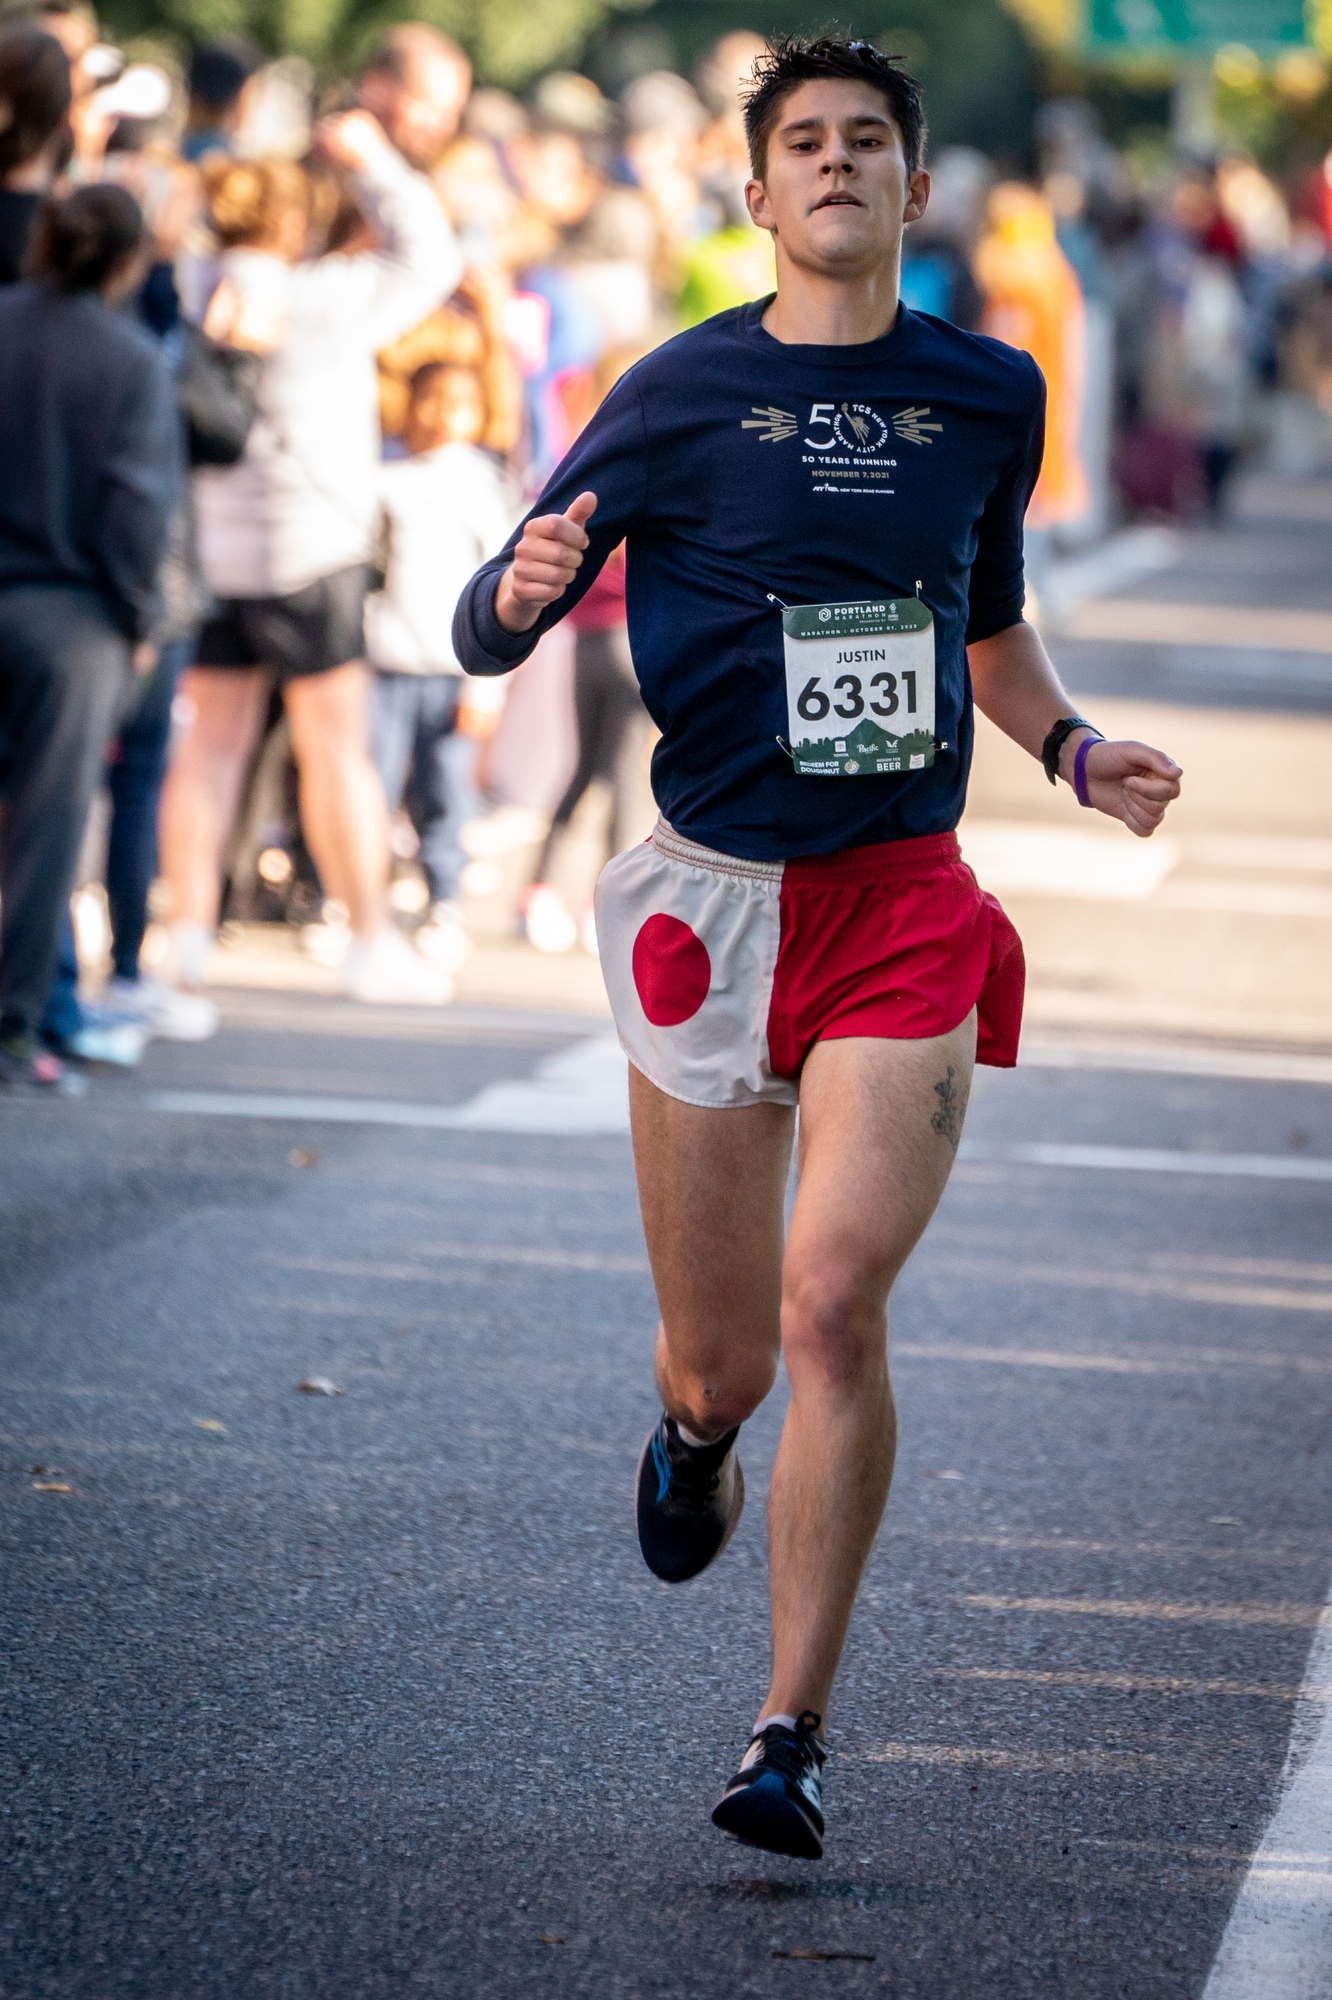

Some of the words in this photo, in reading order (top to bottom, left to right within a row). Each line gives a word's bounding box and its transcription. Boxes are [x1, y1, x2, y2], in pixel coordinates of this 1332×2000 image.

[852, 404, 872, 415] TCS
[871, 412, 887, 429] NEW
[833, 413, 855, 450] MARATHON
[875, 429, 889, 448] YORK
[856, 445, 876, 454] CITY
[801, 455, 815, 463] 50
[818, 456, 850, 465] YEARS
[853, 457, 898, 467] RUNNING
[811, 470, 860, 478] NOVEMBER
[834, 605, 886, 616] PORTLAND
[834, 612, 887, 621] MARATHON
[800, 629, 840, 637] MARATHON
[850, 626, 883, 634] OCTOBER
[836, 649, 886, 664] JUSTIN
[796, 670, 917, 722] 6331
[799, 760, 825, 768] REDEEM
[825, 760, 840, 768] FOR
[876, 761, 901, 772] BEER
[800, 766, 840, 775] DOUGHNUT
